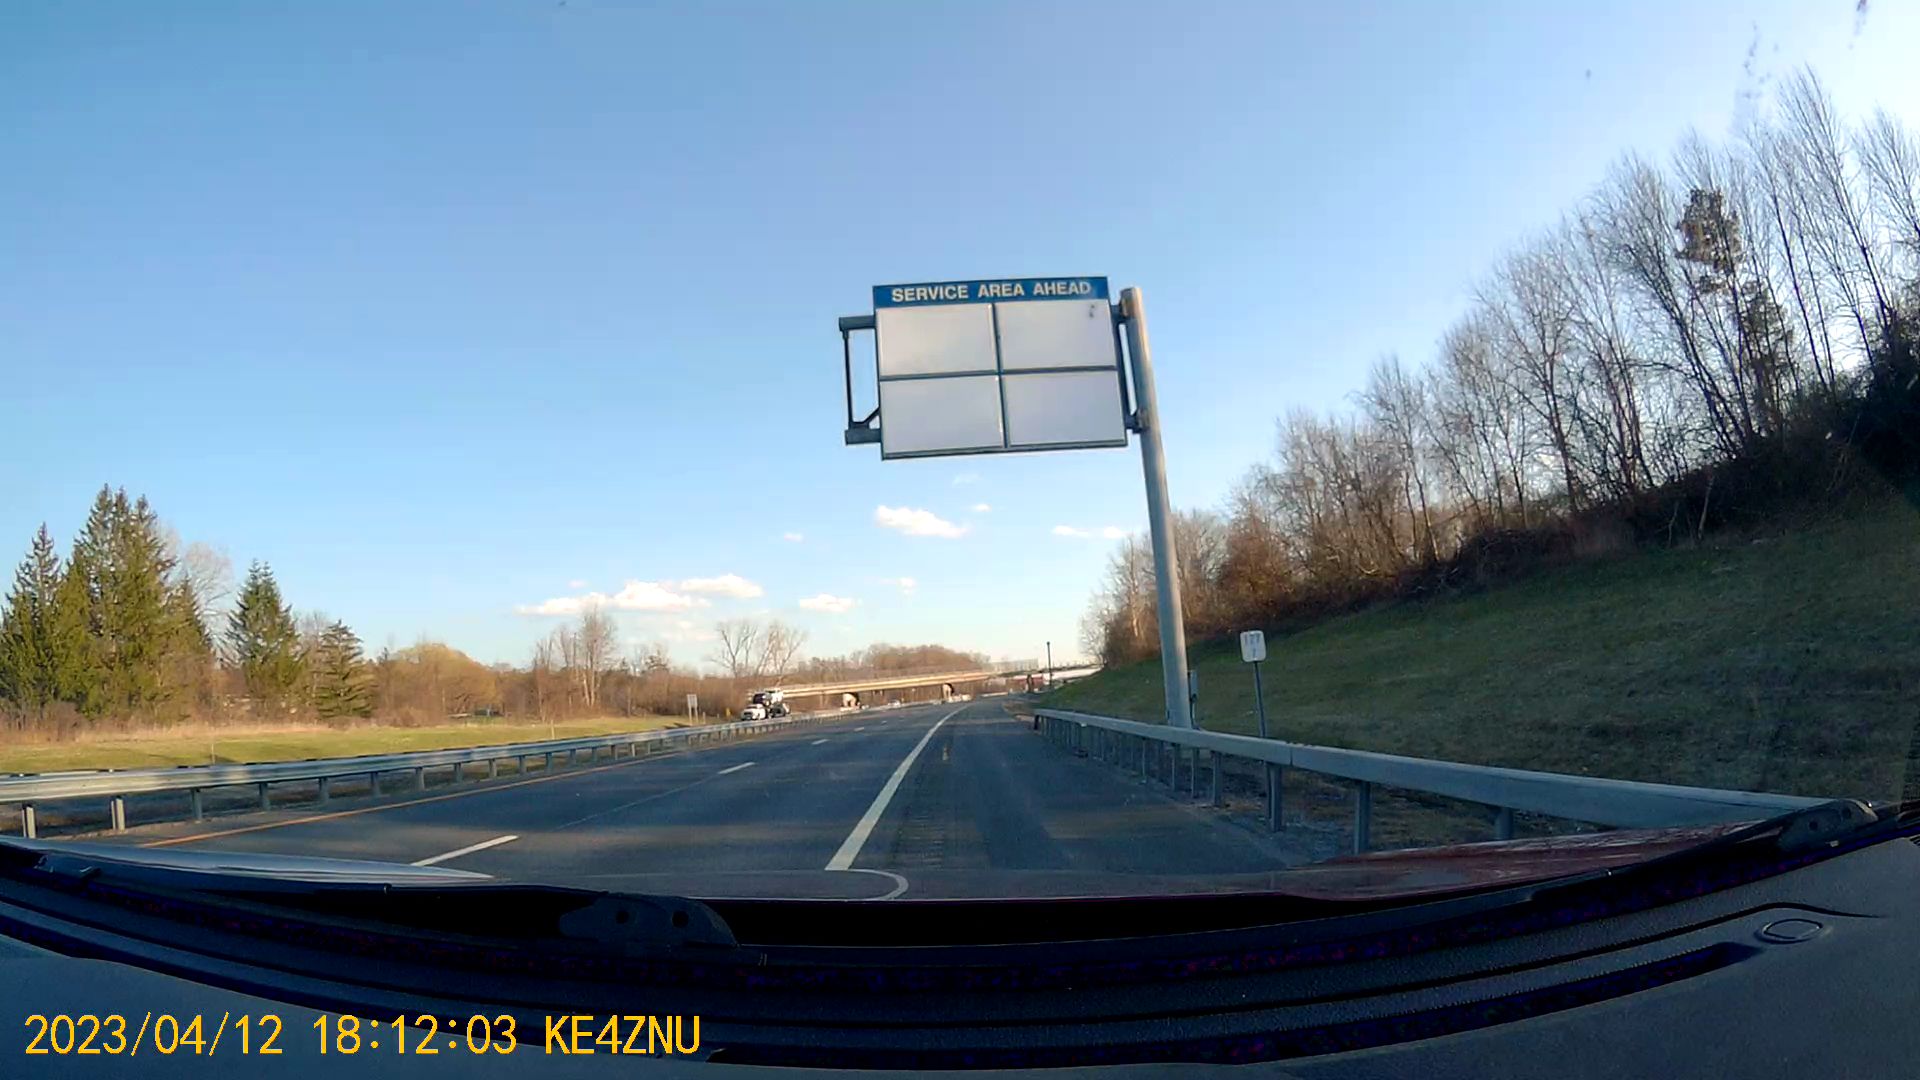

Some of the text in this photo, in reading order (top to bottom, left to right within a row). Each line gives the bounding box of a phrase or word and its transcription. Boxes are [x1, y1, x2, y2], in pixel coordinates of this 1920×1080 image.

[891, 281, 1091, 303] SERVICE AREA AHEAD
